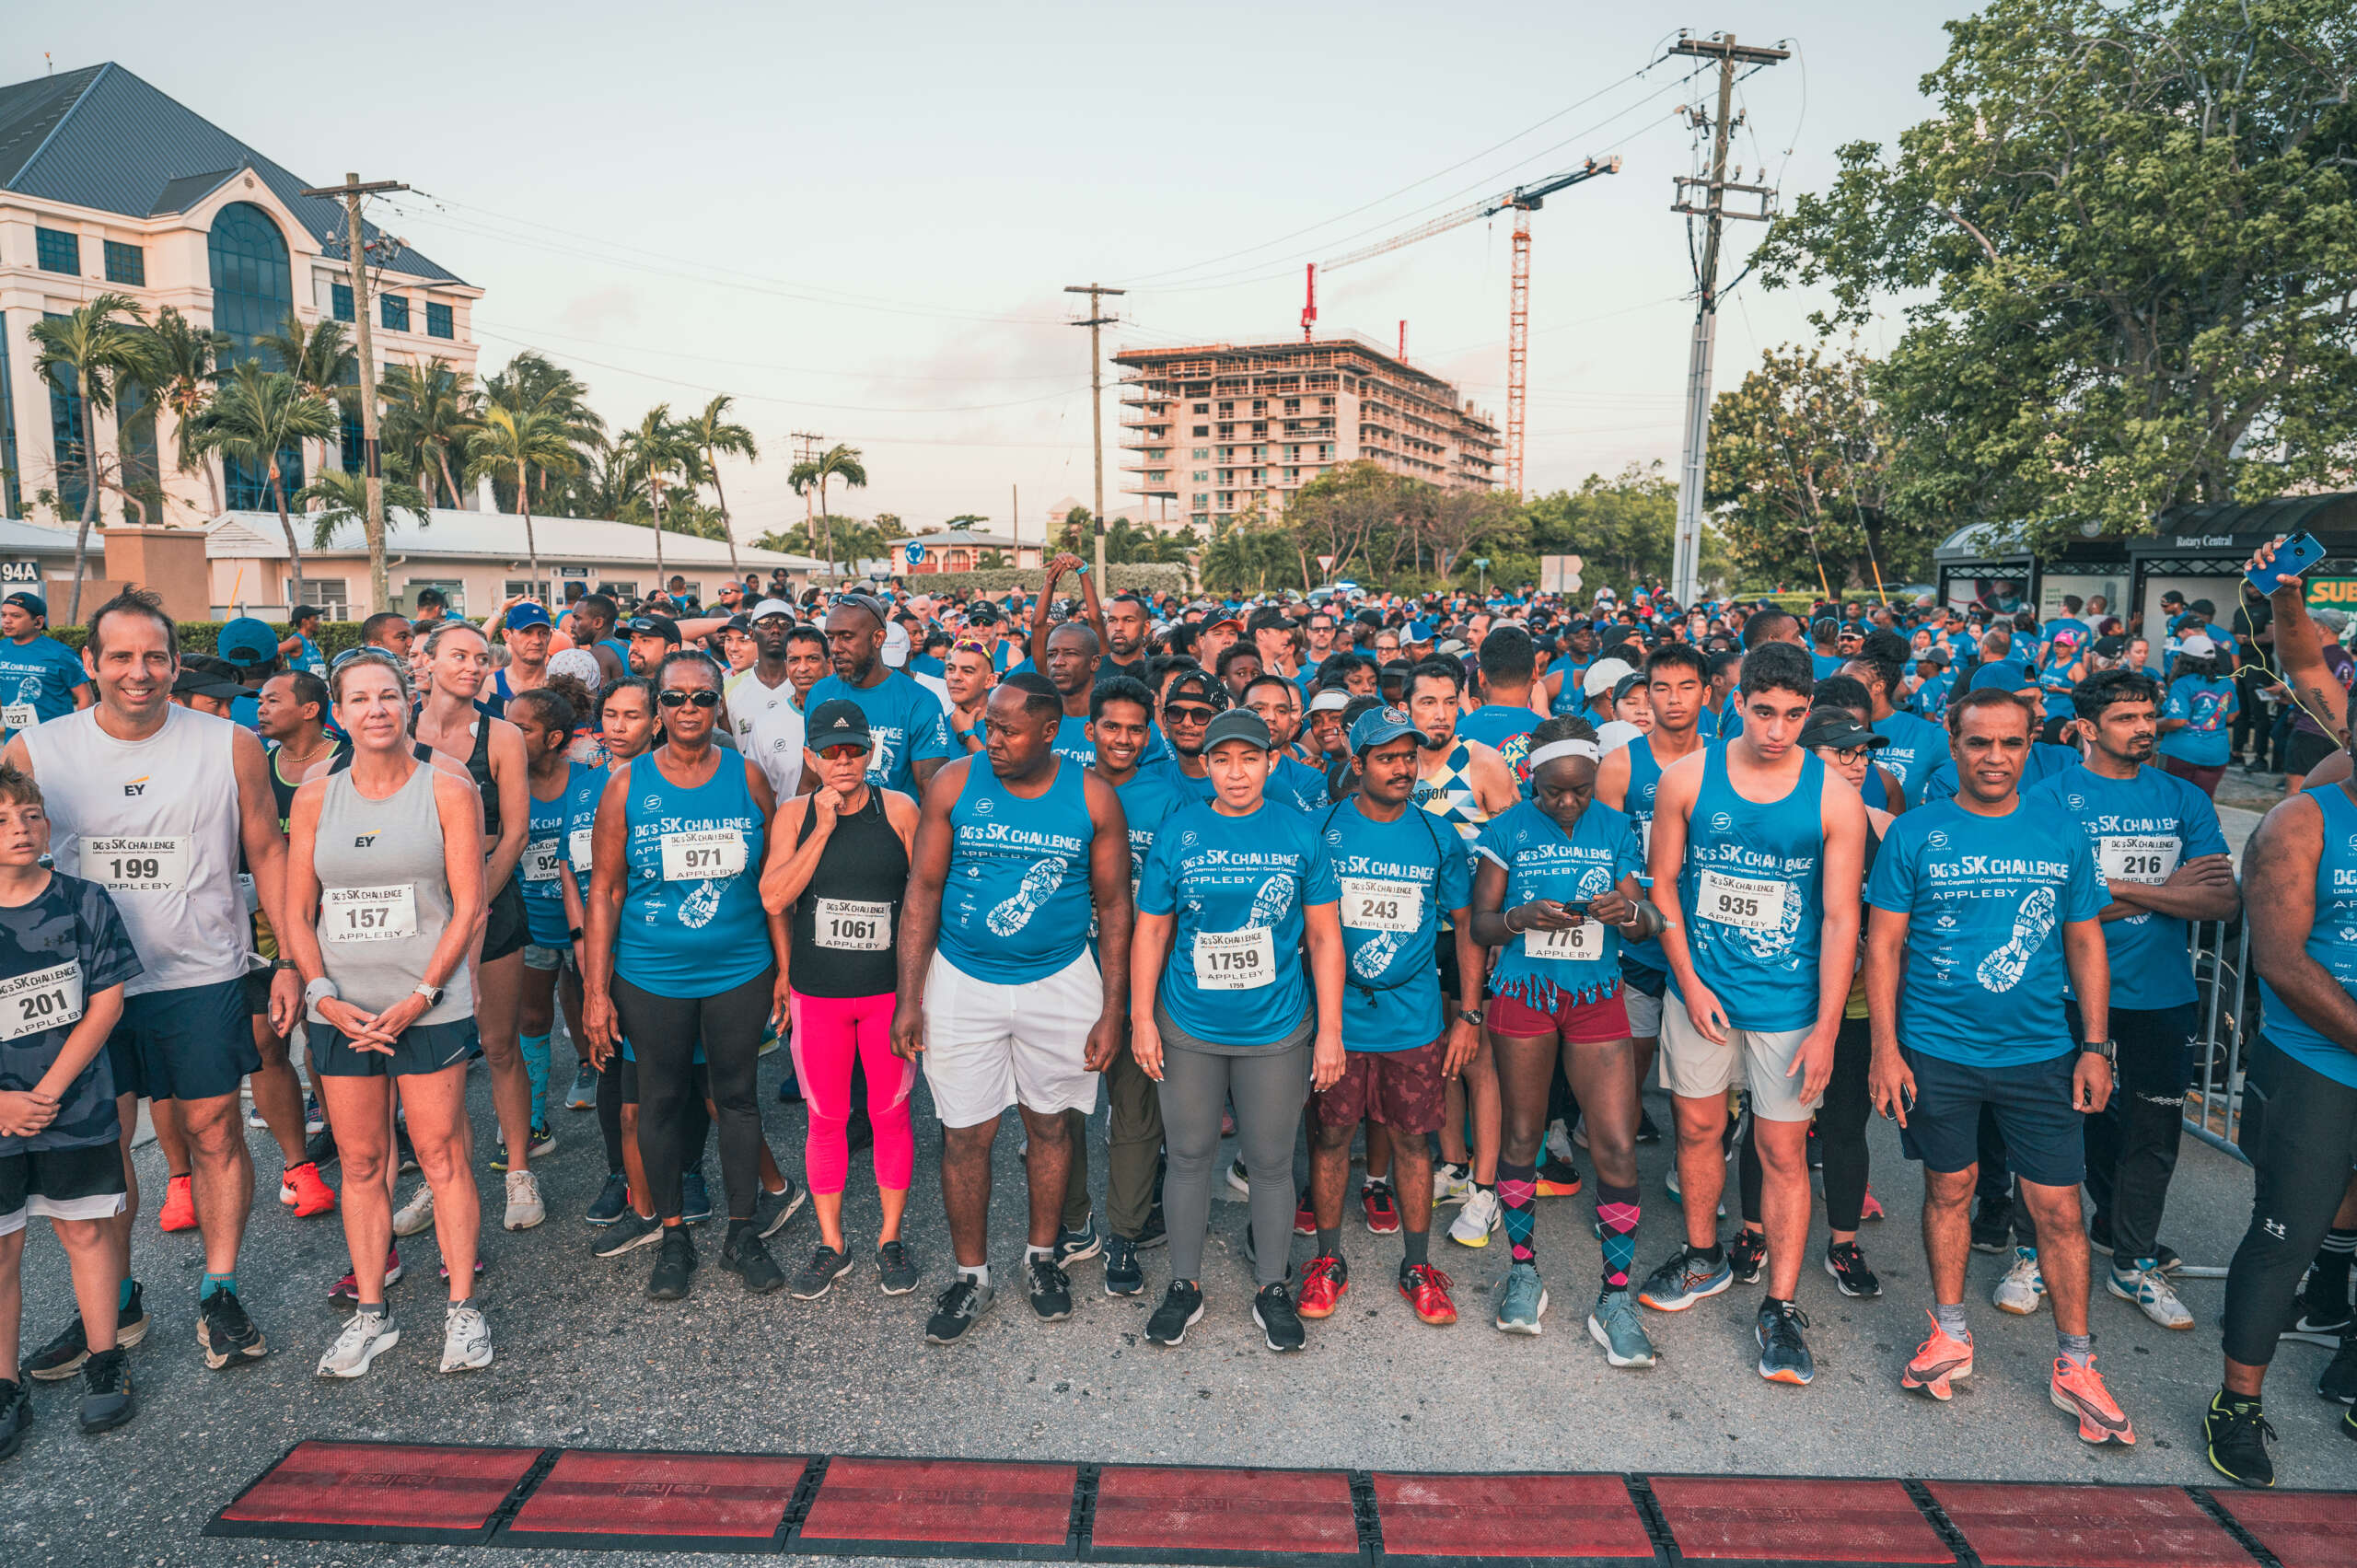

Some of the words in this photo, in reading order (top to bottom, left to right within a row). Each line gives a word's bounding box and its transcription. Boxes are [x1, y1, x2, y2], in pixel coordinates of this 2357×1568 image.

[2177, 536, 2201, 550] Rotary
[2202, 534, 2233, 546] Central
[2, 563, 38, 581] 94A
[2307, 582, 2357, 603] SUB
[124, 784, 145, 796] EY
[529, 819, 540, 829] K
[660, 818, 682, 832] 5K
[684, 818, 752, 831] CHALLENGE
[2099, 815, 2121, 832] 5K
[111, 839, 127, 849] 5K
[354, 836, 376, 847] EY
[686, 833, 698, 842] 5K
[698, 833, 735, 842] CHALLENGE
[986, 823, 1010, 842] 5K
[1010, 830, 1082, 852] CHALLENGE
[2127, 839, 2138, 848] 5K
[685, 848, 722, 868] 971
[1206, 849, 1230, 865] 5K
[1231, 853, 1300, 867] CHALLENGE
[1538, 843, 1558, 858] 5K
[1719, 843, 1744, 864] 5K
[110, 858, 159, 878] 199
[538, 855, 559, 871] 92
[1348, 855, 1370, 874] 5K
[1371, 862, 1435, 880] CHALLENGE
[1962, 855, 1988, 875] 5K
[1991, 859, 2069, 878] CHALLENGE
[2123, 856, 2162, 874] 216
[677, 869, 736, 878] APPLEBY
[1182, 876, 1256, 884] APPLEBY
[1517, 867, 1579, 877] APPLEBY
[2334, 869, 2357, 886] DG
[1365, 881, 1377, 891] 5K
[1377, 884, 1411, 894] CHALLENGE
[1585, 877, 1603, 895] 5K
[1724, 877, 1736, 888] 5K
[1736, 881, 1774, 893] CHALLENGE
[347, 889, 360, 900] 5K
[361, 889, 402, 900] CHALLENGE
[1264, 886, 1287, 907] 5K
[1933, 889, 2018, 900] APPLEBY
[692, 897, 710, 913] 10
[839, 901, 851, 912] 5K
[851, 905, 885, 914] CHALLENGE
[1362, 899, 1399, 919] 243
[1719, 894, 1759, 916] 935
[2026, 900, 2048, 923] 5K
[346, 908, 389, 928] 157
[1002, 906, 1021, 923] 10
[1708, 912, 1768, 927] APPLEBY
[830, 919, 876, 939] 1061
[1352, 920, 1407, 930] APPLEBY
[339, 930, 402, 940] APPLEBY
[1213, 935, 1224, 945] 5K
[1225, 933, 1261, 945] CHALLENGE
[1548, 929, 1584, 947] 776
[825, 940, 880, 949] APPLEBY
[1208, 949, 1260, 970] 1759
[1366, 947, 1384, 964] 10
[1536, 949, 1592, 958] APPLEBY
[1993, 956, 2016, 976] 10
[14, 977, 30, 990] 5K
[30, 966, 76, 986] CHALLENGE
[1208, 970, 1264, 980] APPLEBY
[1937, 972, 1948, 981] EY
[1988, 966, 2010, 983] YEARS
[19, 989, 68, 1020] 201
